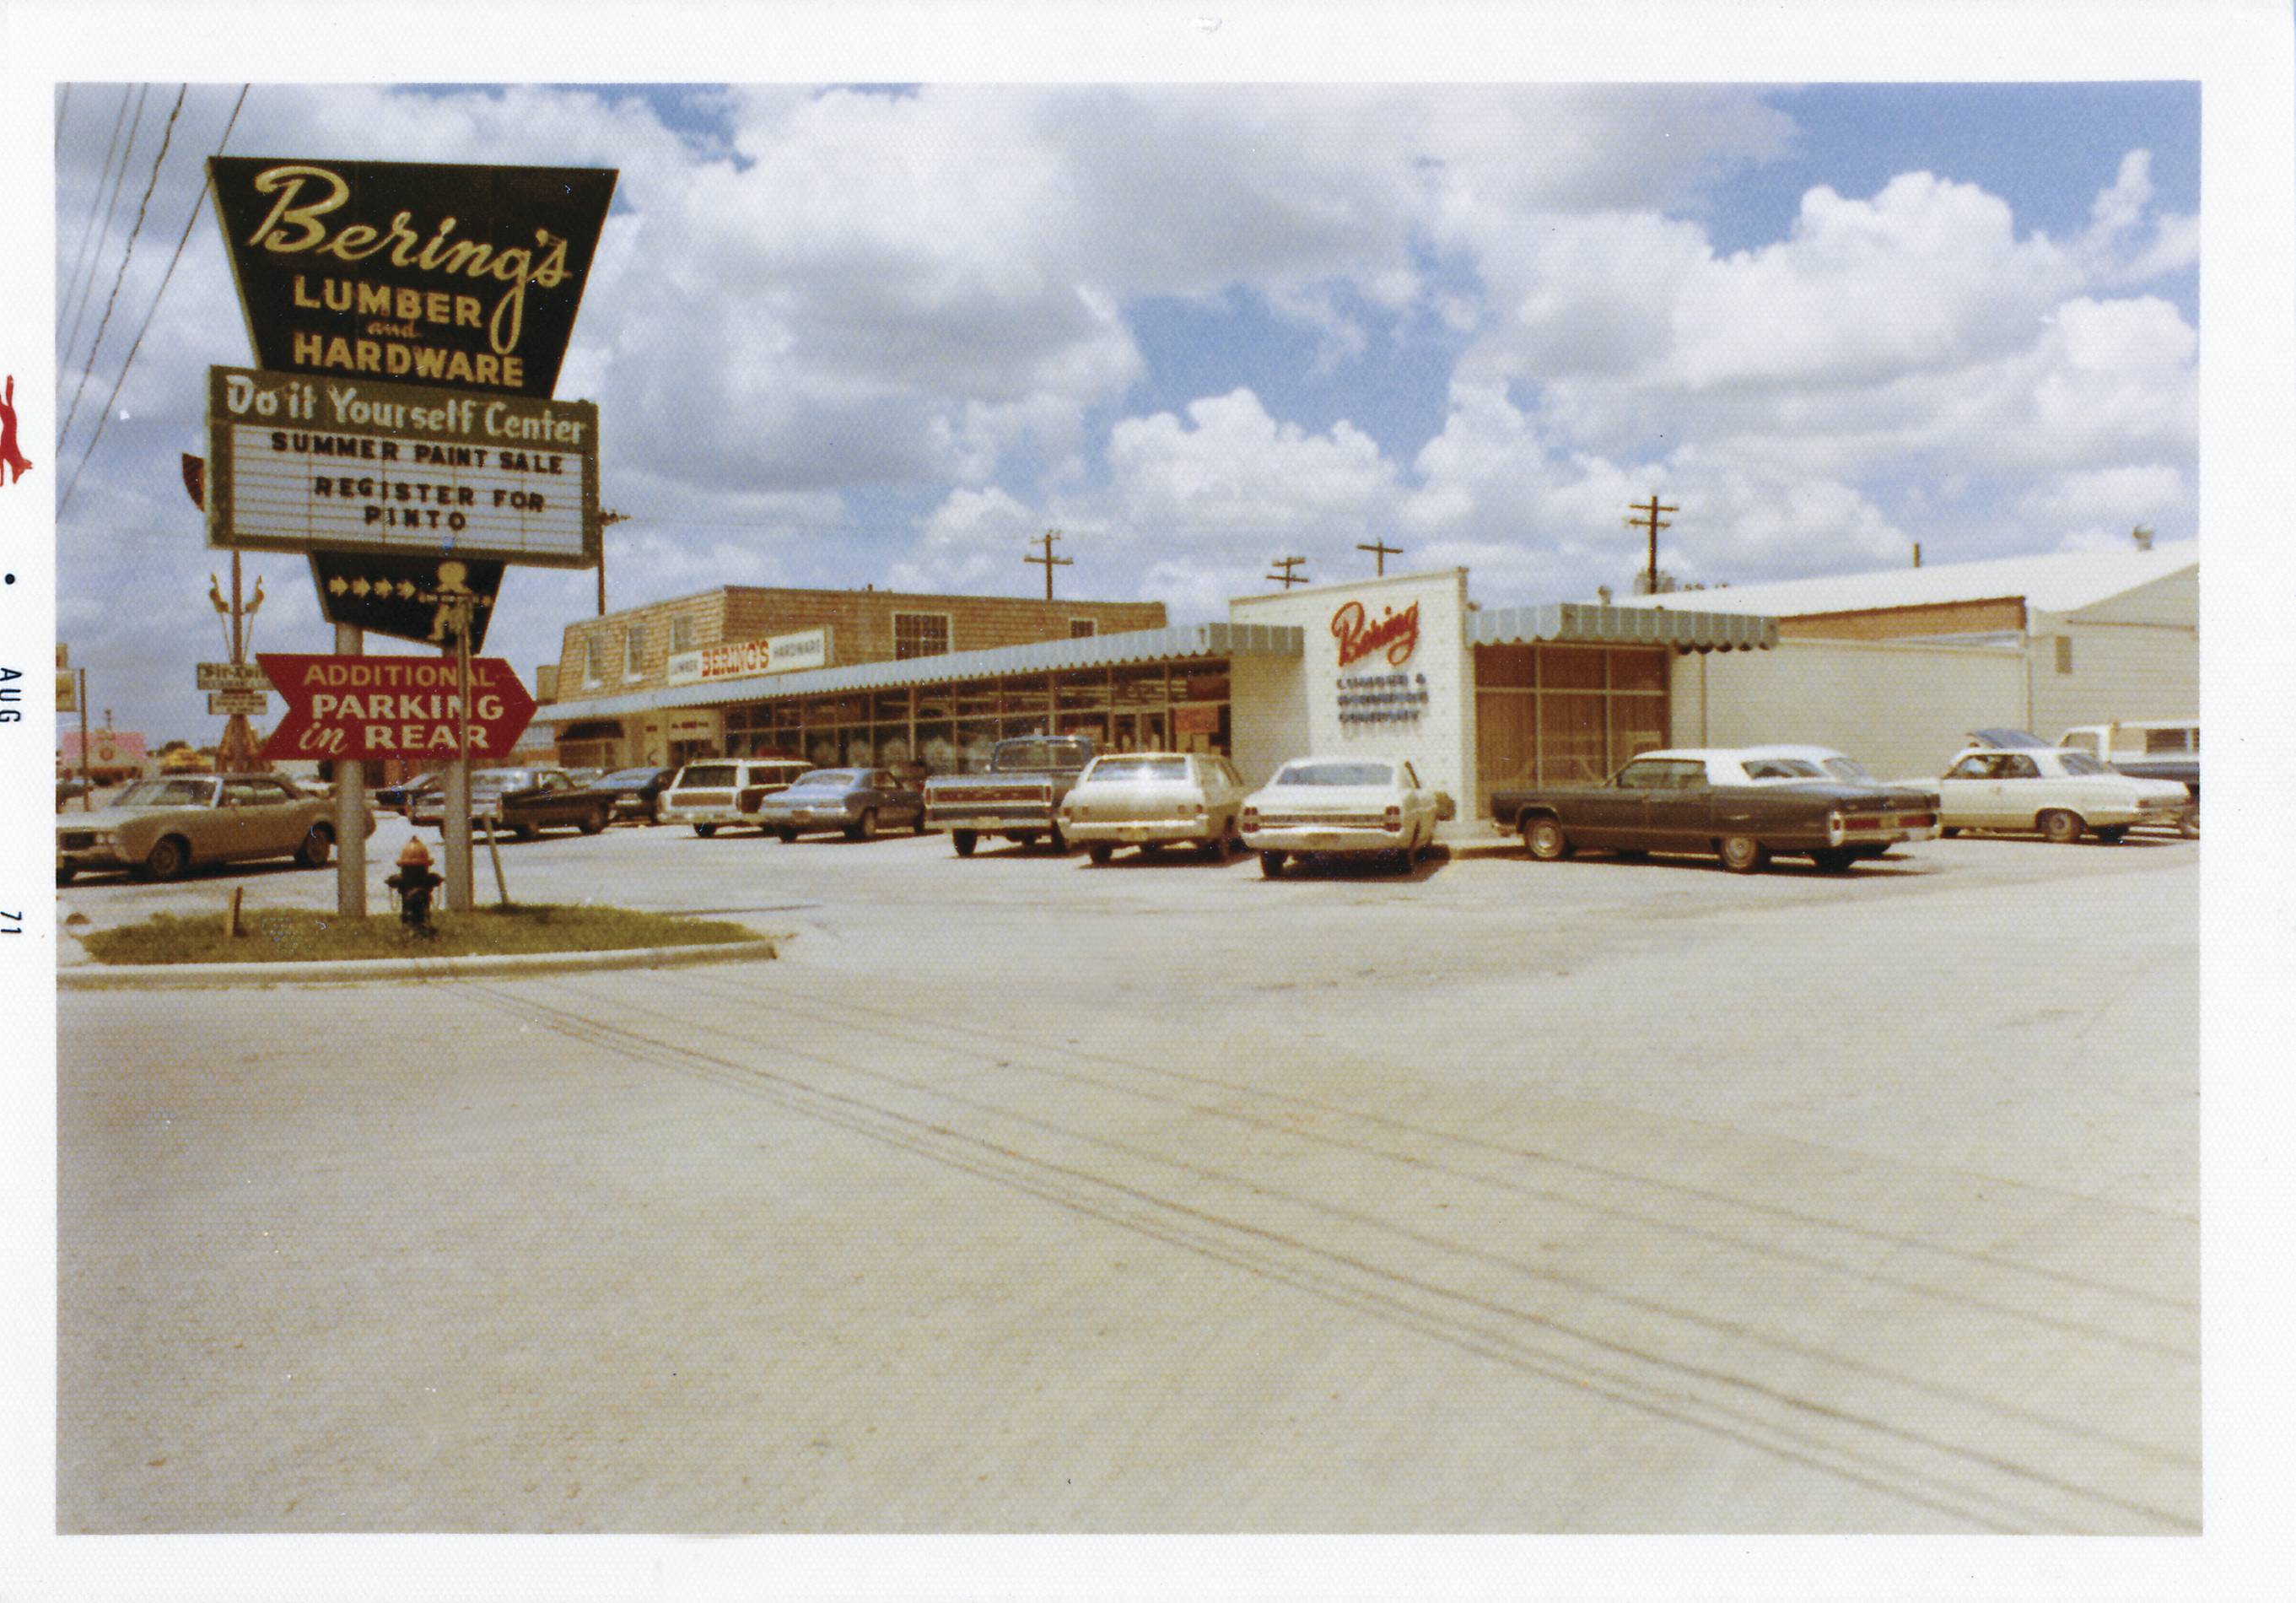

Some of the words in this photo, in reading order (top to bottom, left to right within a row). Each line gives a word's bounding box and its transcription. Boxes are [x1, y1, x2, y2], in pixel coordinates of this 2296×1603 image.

[245, 165, 571, 355] Bering's
[293, 274, 482, 328] LUMBER
[367, 320, 418, 338] and
[293, 331, 525, 387] HARDWARE
[224, 374, 278, 415] Do
[288, 384, 318, 419] it
[326, 386, 475, 434] Yourself
[484, 401, 588, 445] Center
[270, 431, 399, 461] SUMMER
[414, 444, 488, 468] PAINT
[499, 451, 564, 476] SALE
[315, 476, 475, 506] REGISTER
[493, 488, 545, 513] FOR
[364, 505, 466, 532] PINTO
[304, 664, 497, 688] ADDITIONAL
[311, 694, 505, 720] PARKING
[299, 721, 348, 754] in
[364, 724, 490, 750] REAR
